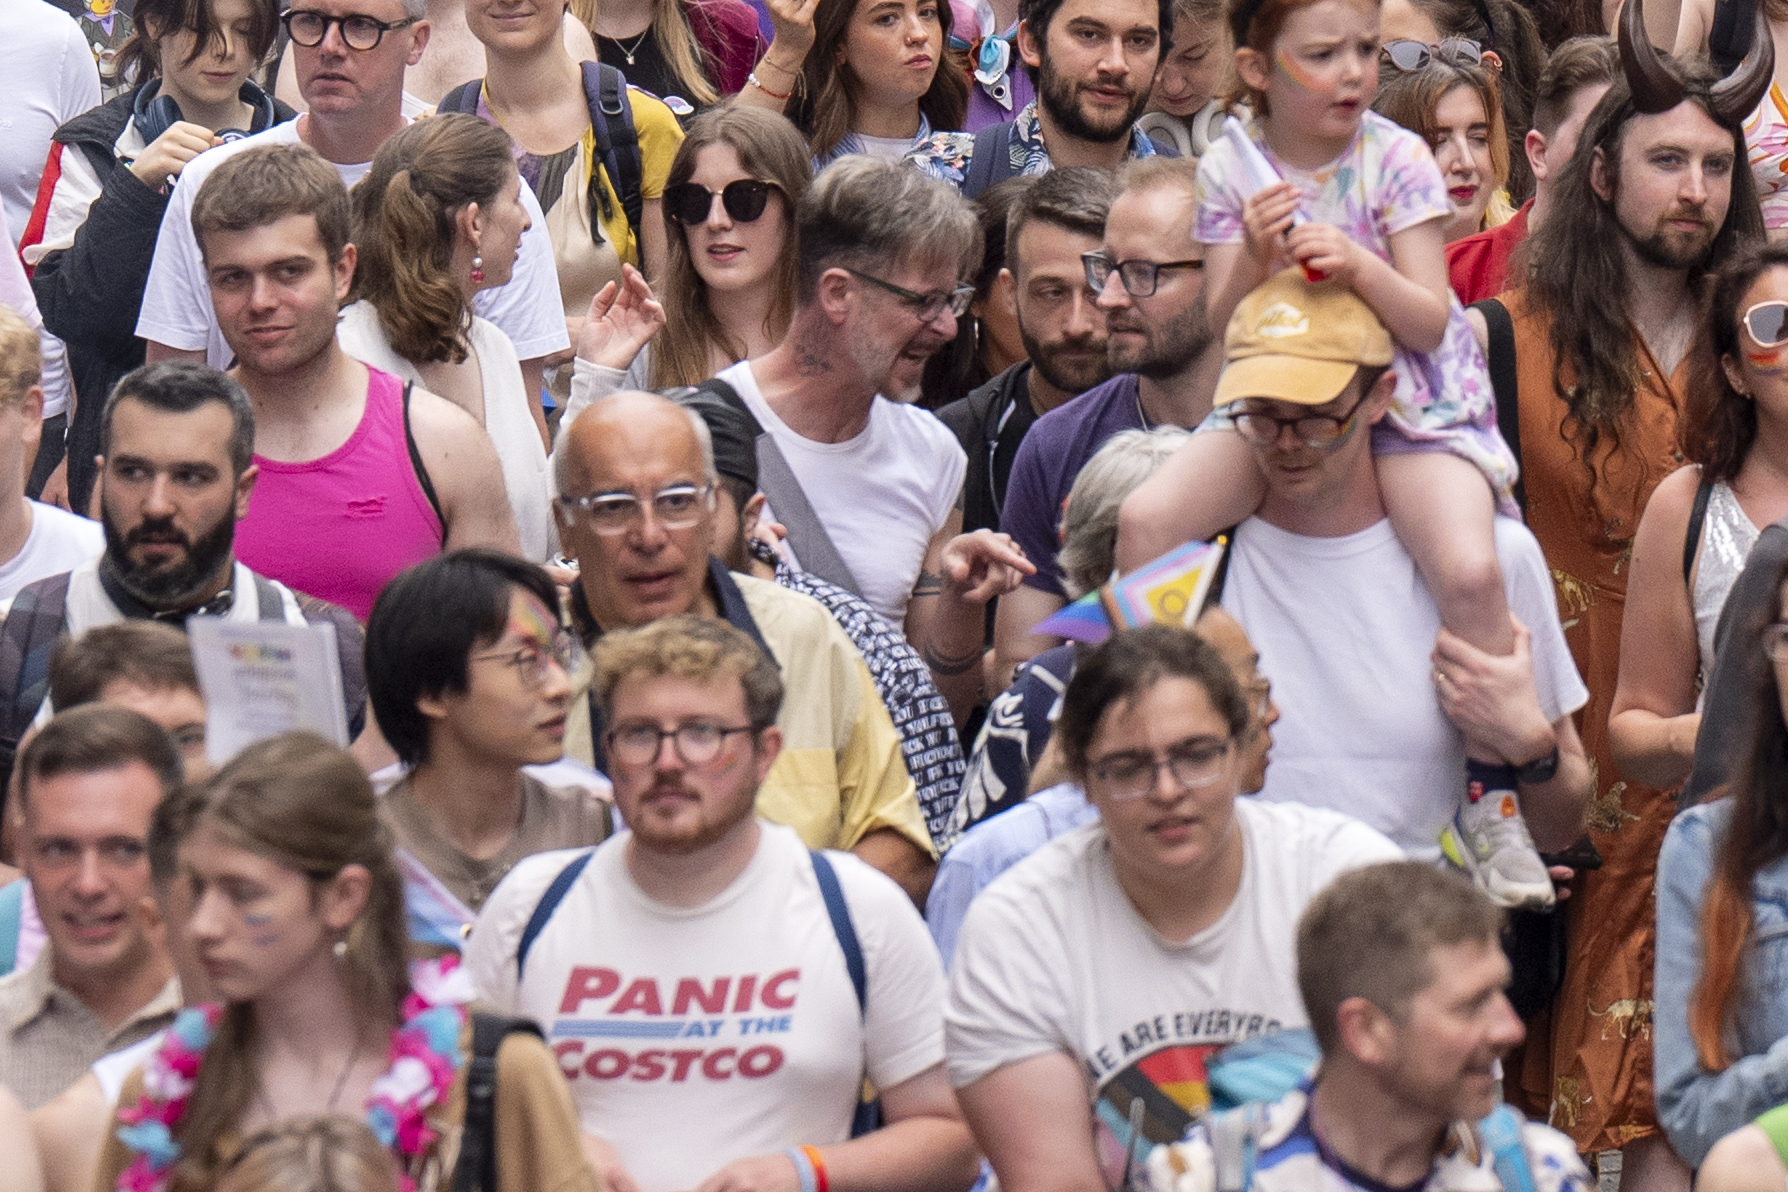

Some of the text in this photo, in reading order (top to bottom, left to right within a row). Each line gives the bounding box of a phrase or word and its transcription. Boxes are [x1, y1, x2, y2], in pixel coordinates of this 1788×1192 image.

[558, 965, 802, 1015] PANIC
[683, 1015, 793, 1039] AT THE
[1119, 1014, 1166, 1056] ARE
[553, 1040, 785, 1083] COSTCO
